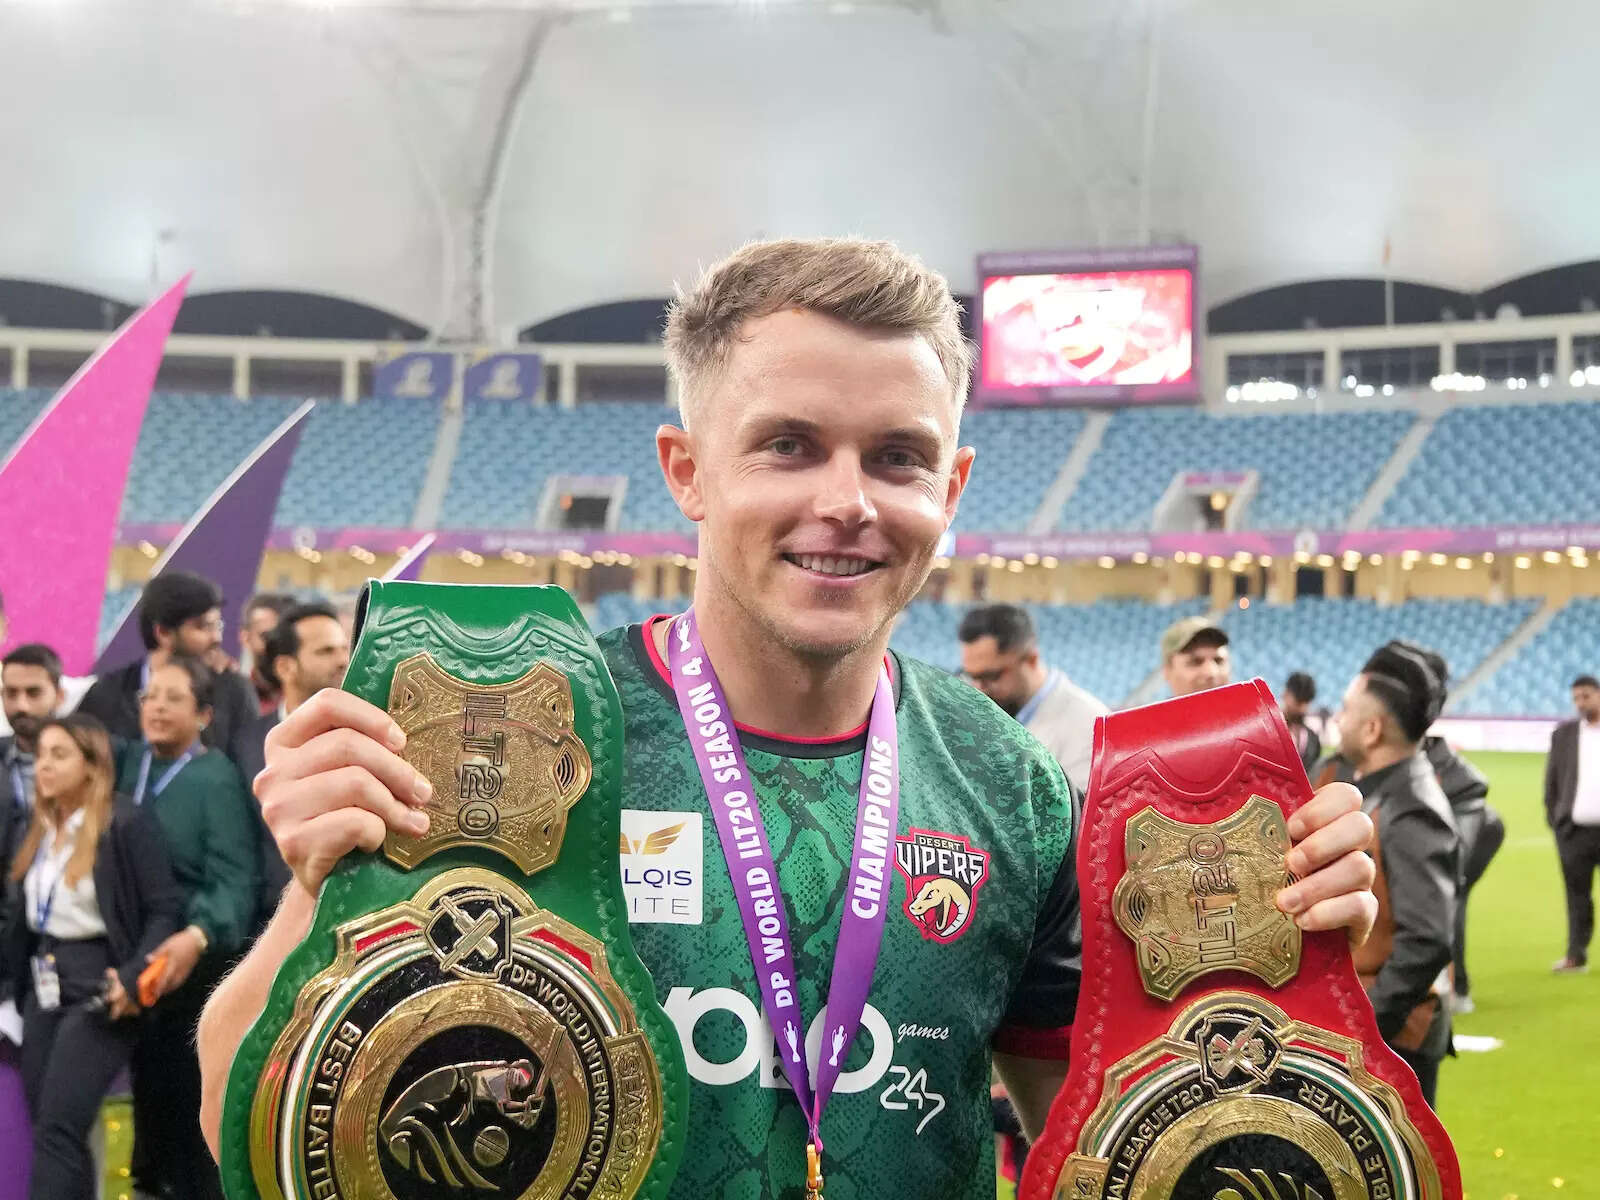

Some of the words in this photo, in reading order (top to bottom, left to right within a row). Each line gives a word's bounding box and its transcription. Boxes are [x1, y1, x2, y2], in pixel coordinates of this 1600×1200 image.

[681, 656, 703, 676] 4
[687, 681, 742, 784] SEASON
[723, 790, 764, 860] ILT20
[851, 735, 893, 920] CHAMPIONS
[918, 835, 961, 850] DESERT
[624, 868, 693, 888] LQIS
[895, 842, 985, 884] VIPERS
[633, 896, 690, 916] ITE
[745, 866, 786, 964] WORLD
[769, 970, 794, 1009] DP
[316, 1020, 363, 1100] BEST
[897, 1021, 951, 1043] games
[537, 977, 591, 1041] WORLD
[570, 1037, 610, 1193] INTERNATIONAL
[610, 1053, 645, 1172] SEASON
[1297, 1079, 1373, 1151] PLAYER
[1117, 1103, 1174, 1172] LEAGUE
[1168, 1083, 1204, 1113] T20
[1074, 1176, 1098, 1197] 4
